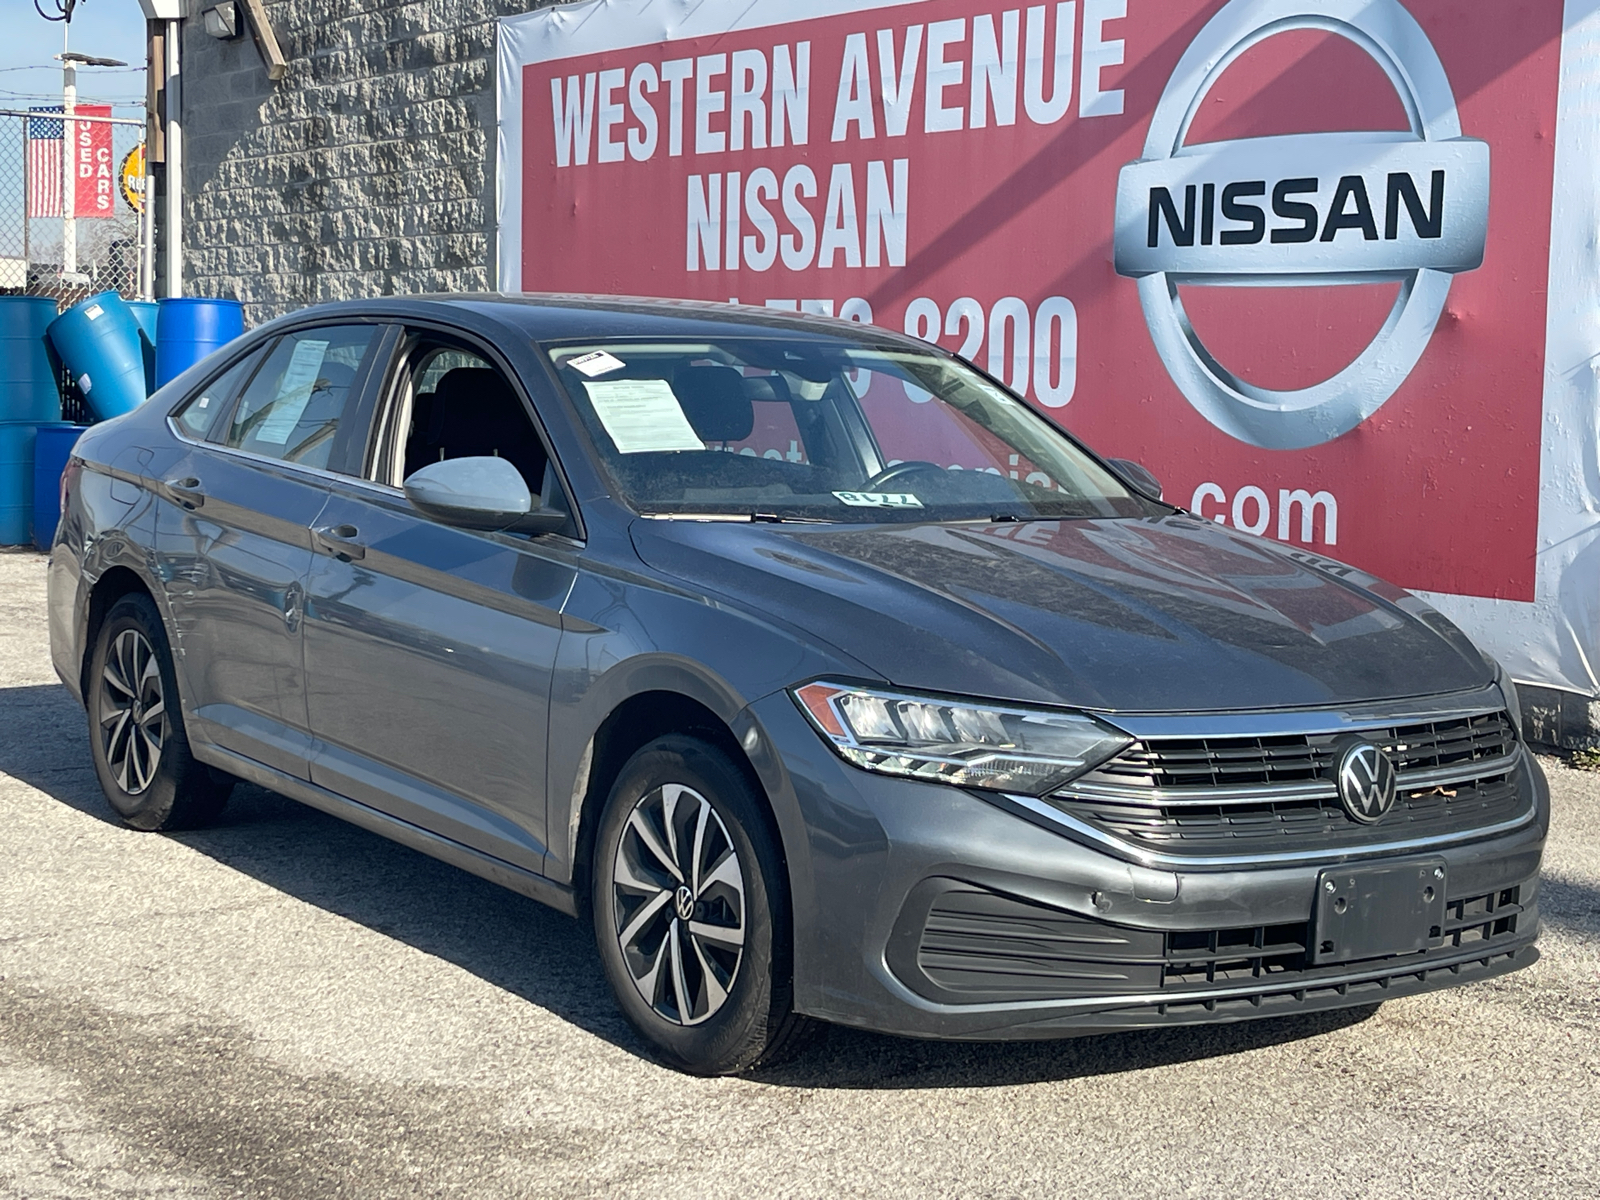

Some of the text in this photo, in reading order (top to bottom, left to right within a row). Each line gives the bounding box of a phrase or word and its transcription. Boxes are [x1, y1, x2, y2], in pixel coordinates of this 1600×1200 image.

[551, 0, 1128, 168] WESTERN AVENUE
[79, 120, 110, 210] USED CARS
[686, 158, 909, 272] NISSAN
[1147, 169, 1445, 248] NISSAN
